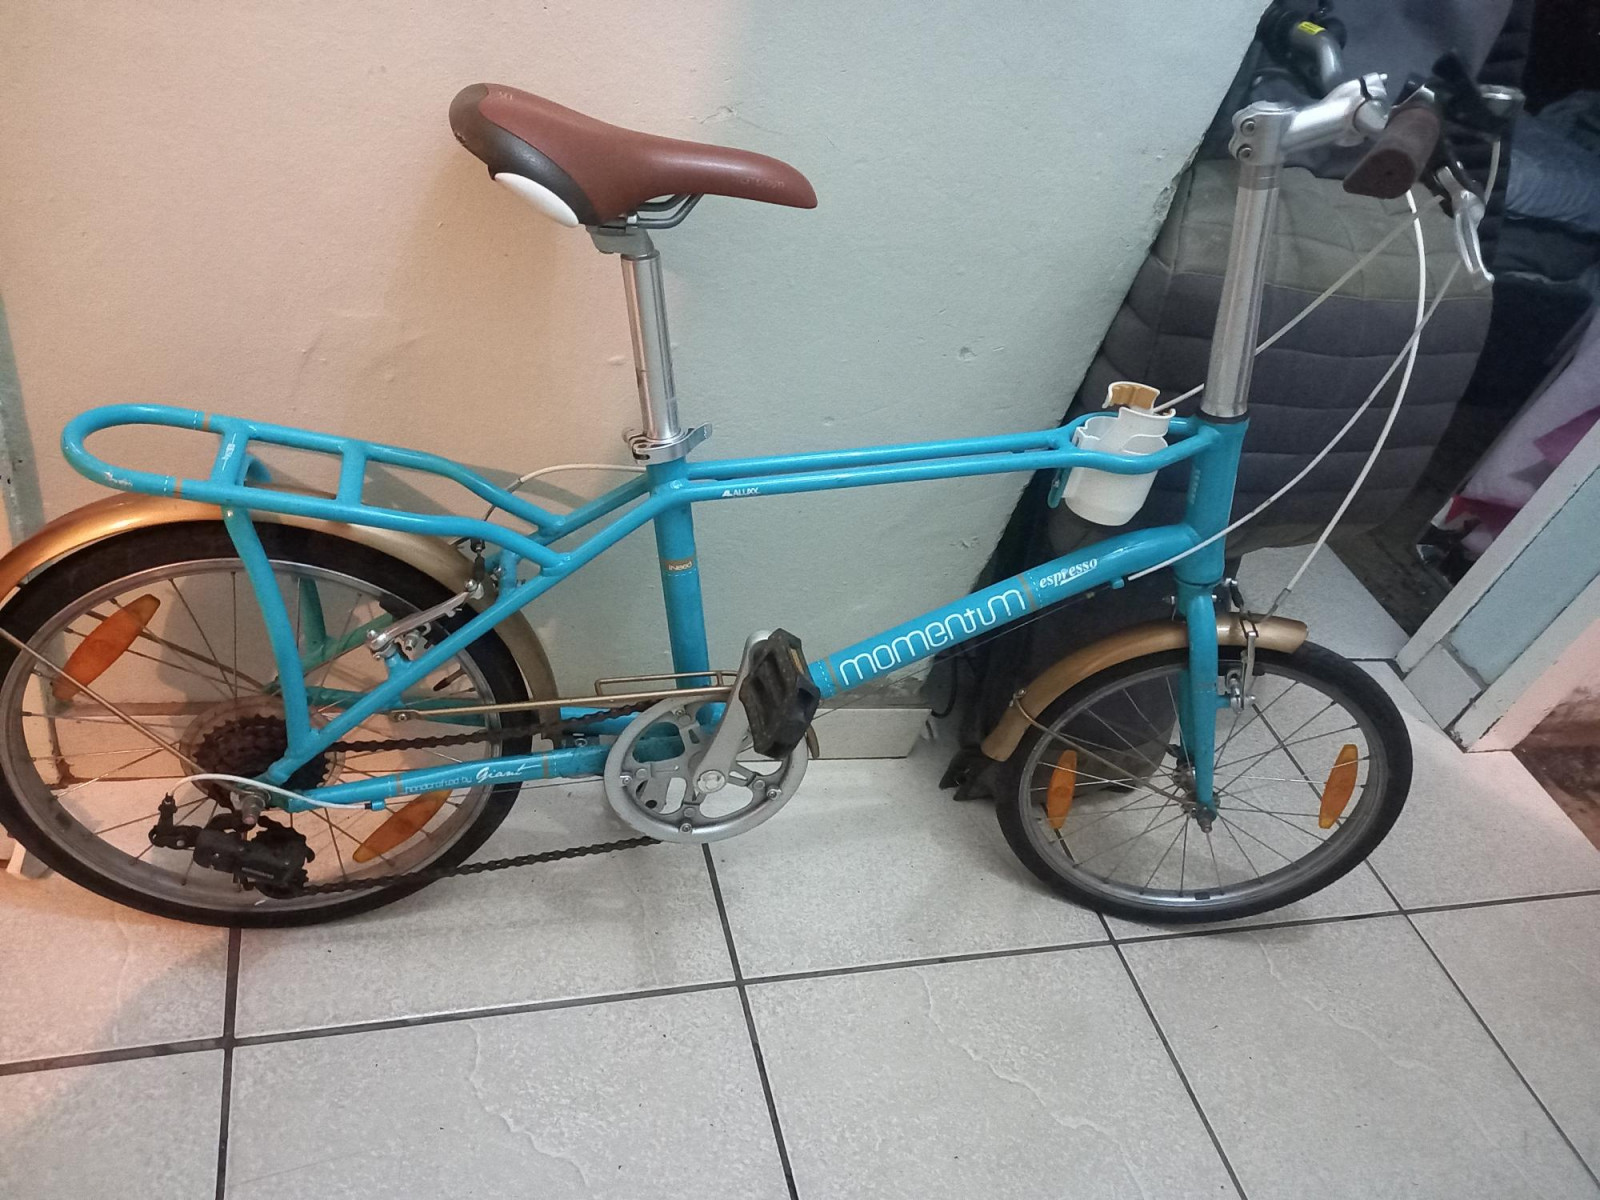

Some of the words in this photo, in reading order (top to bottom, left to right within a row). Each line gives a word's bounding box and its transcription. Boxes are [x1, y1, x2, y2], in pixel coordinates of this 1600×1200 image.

[840, 589, 1025, 685] momentum
[1039, 558, 1098, 588] espresso
[476, 764, 541, 782] Giant
